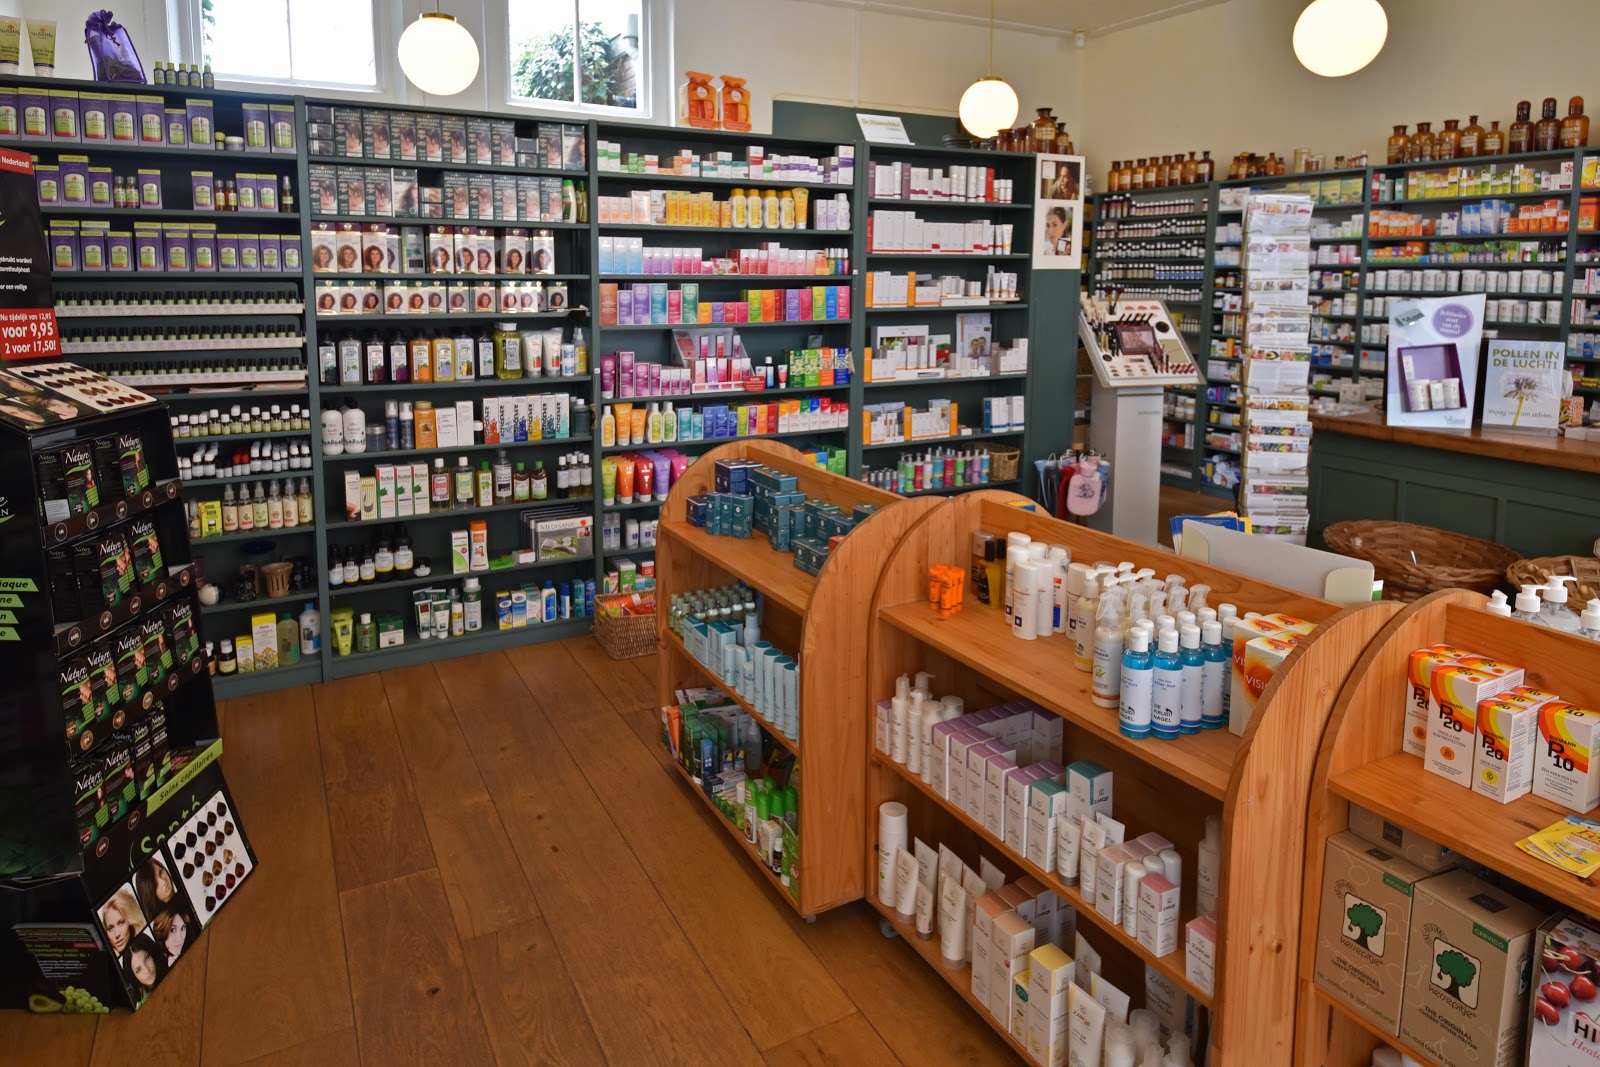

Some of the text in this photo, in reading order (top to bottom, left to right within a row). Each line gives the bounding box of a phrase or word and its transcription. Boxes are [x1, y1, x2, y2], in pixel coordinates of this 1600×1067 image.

[2, 156, 29, 168] Nederland!
[9, 313, 28, 324] tijdelijk
[39, 312, 52, 322] 12,95
[2, 322, 54, 340] voor 9,95
[5, 340, 57, 354] 2 voor 17,50!
[1492, 349, 1560, 359] POLLEN IN
[1493, 358, 1557, 369] DE LUCHT!
[120, 435, 140, 449] Nature
[65, 449, 90, 465] Nature
[131, 522, 154, 536] Nature
[541, 522, 575, 530] MEDISANA
[100, 541, 123, 555] Nature
[172, 605, 191, 620] Nature
[142, 620, 163, 635] Nature
[117, 635, 142, 653] Nature
[88, 651, 111, 667] Nature
[60, 666, 87, 684] Nature
[1246, 674, 1269, 691] VISI
[1413, 687, 1425, 700] P
[1153, 714, 1173, 723] NAGEL
[1439, 703, 1454, 719] P
[1443, 716, 1463, 733] 20
[1482, 735, 1496, 749] P
[1548, 740, 1566, 758] P
[105, 748, 130, 770] Nature
[1485, 746, 1504, 761] 20
[1552, 753, 1575, 773] 10
[74, 770, 102, 795] Nature
[160, 751, 215, 802] Soins capillaires
[1474, 928, 1505, 949] CERVICO
[1335, 955, 1381, 988] THE ORIGINAL
[1370, 1005, 1396, 1025] natural
[1418, 1008, 1439, 1026] CHERRY
[1457, 1033, 1479, 1052] PILLOW
[1424, 1004, 1473, 1043] THE ORIGINAL
